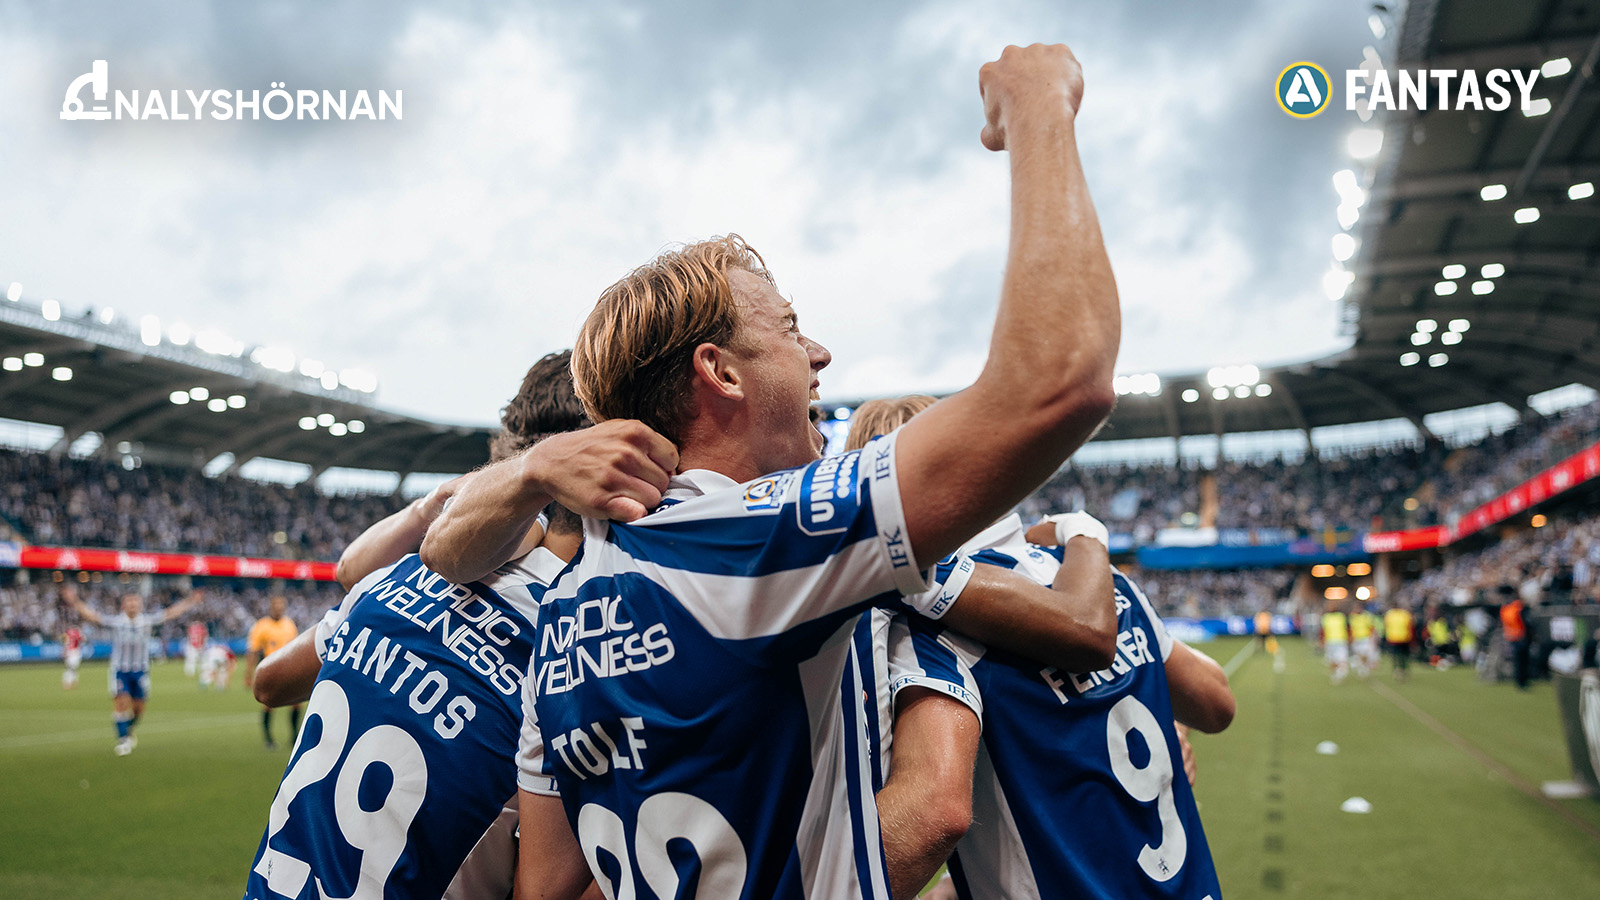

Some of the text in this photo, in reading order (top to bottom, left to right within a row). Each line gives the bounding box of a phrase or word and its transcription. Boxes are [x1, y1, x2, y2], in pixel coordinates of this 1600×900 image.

[876, 444, 890, 481] IFK
[883, 526, 909, 569] IFK
[405, 564, 521, 647] NORDIC
[540, 595, 634, 657] NODIC
[930, 591, 954, 615] IFK
[368, 578, 525, 696] WELLNESS
[327, 621, 476, 739] SANTOS
[946, 683, 972, 704] IFK
[551, 716, 647, 780] TOLF
[253, 680, 428, 900] 29
[1106, 694, 1187, 882] 9
